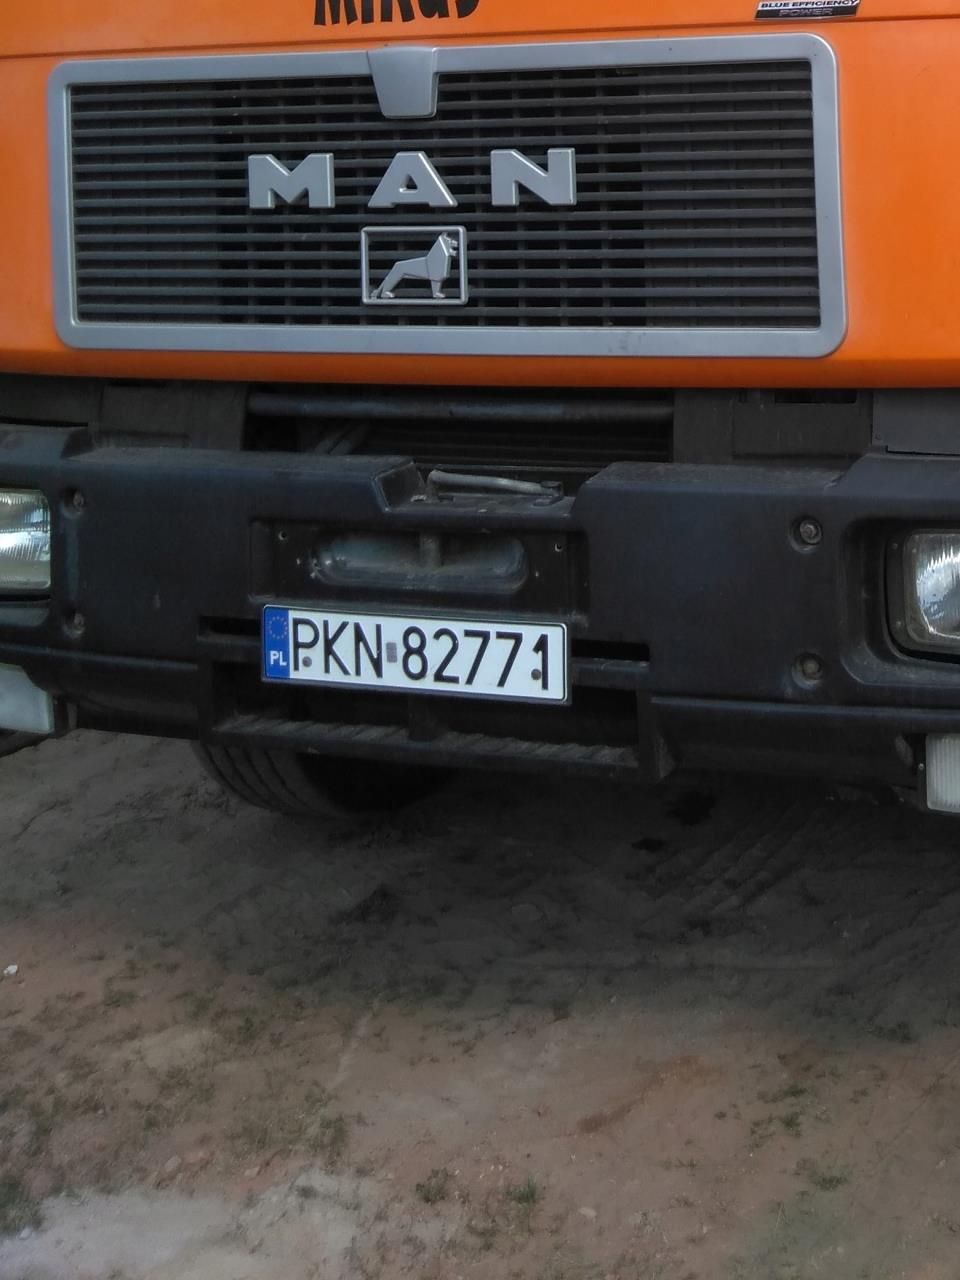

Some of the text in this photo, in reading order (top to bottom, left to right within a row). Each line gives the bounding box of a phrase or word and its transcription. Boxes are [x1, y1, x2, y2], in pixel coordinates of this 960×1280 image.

[792, 0, 857, 7] EFFICIENCY
[779, 8, 833, 17] POWER
[248, 147, 577, 208] MAN
[270, 651, 287, 666] PL
[293, 617, 549, 691] PKN 82771
